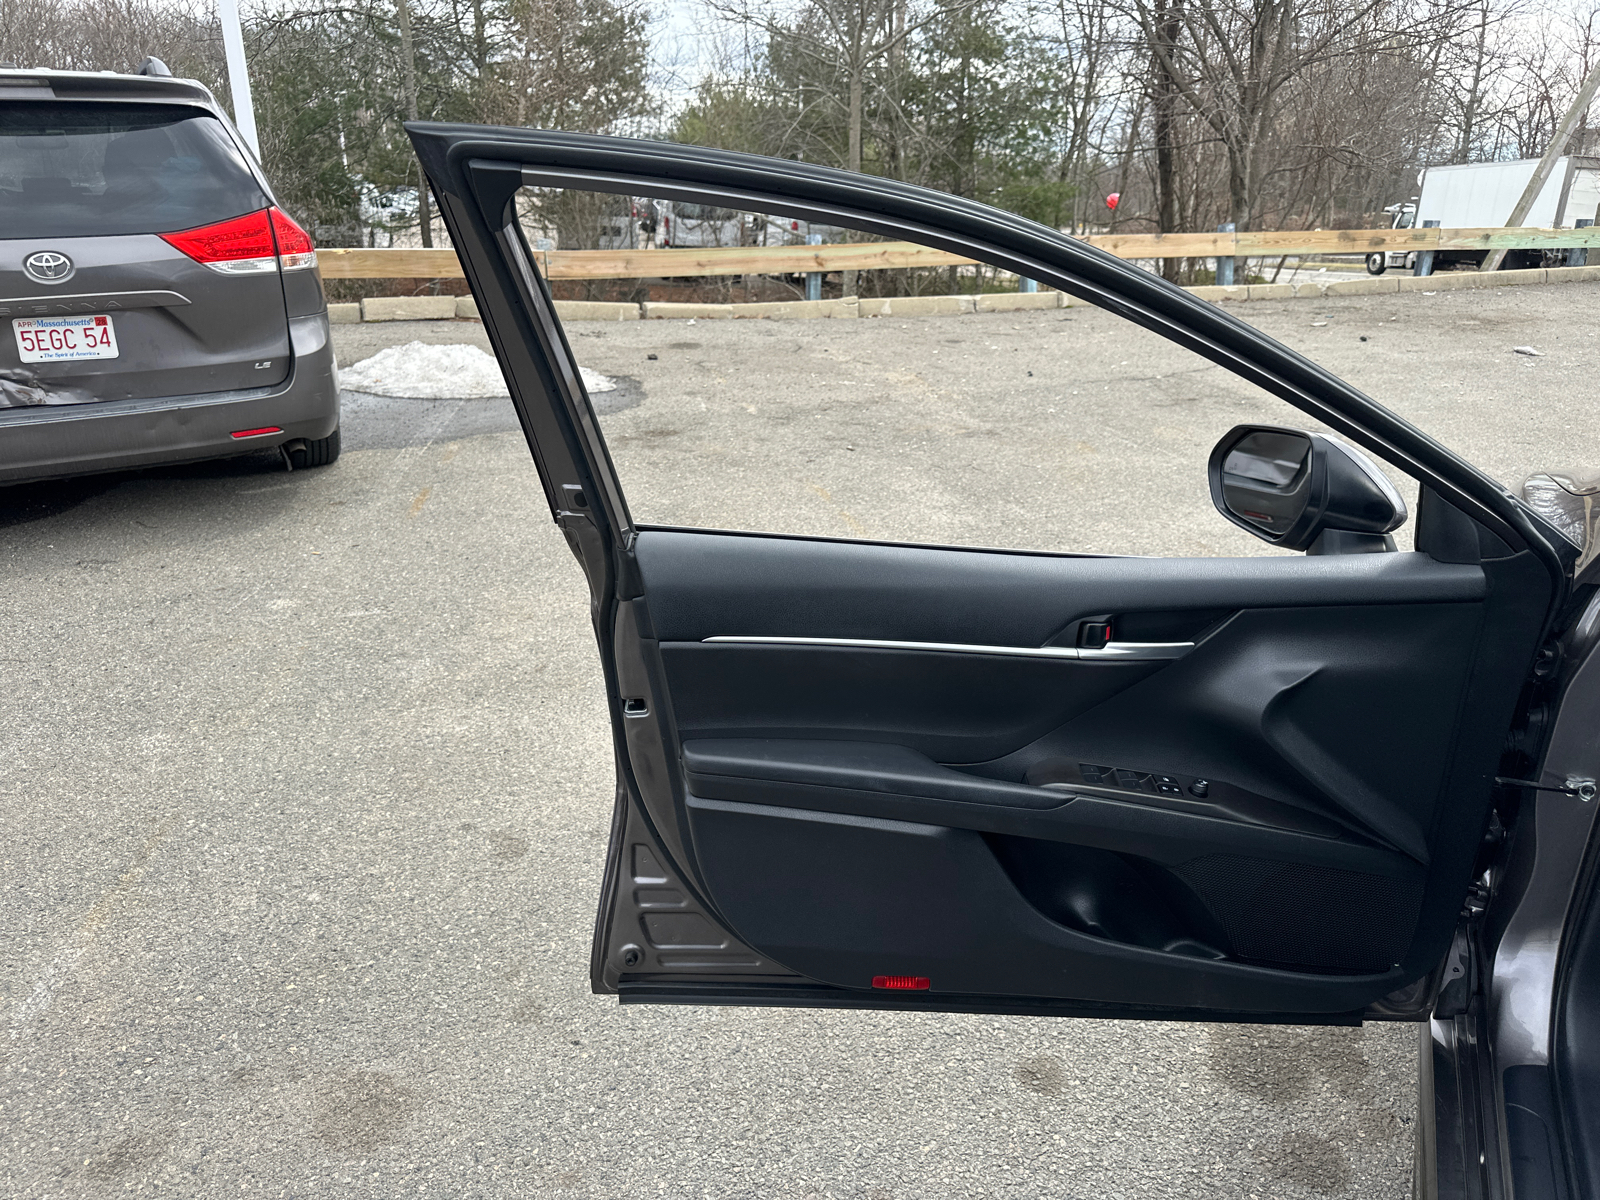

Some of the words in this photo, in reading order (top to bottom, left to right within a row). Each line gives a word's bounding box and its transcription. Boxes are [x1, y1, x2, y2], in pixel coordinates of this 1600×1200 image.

[36, 319, 91, 328] Massachusetts
[20, 329, 77, 351] 5EGC
[83, 327, 111, 348] 54
